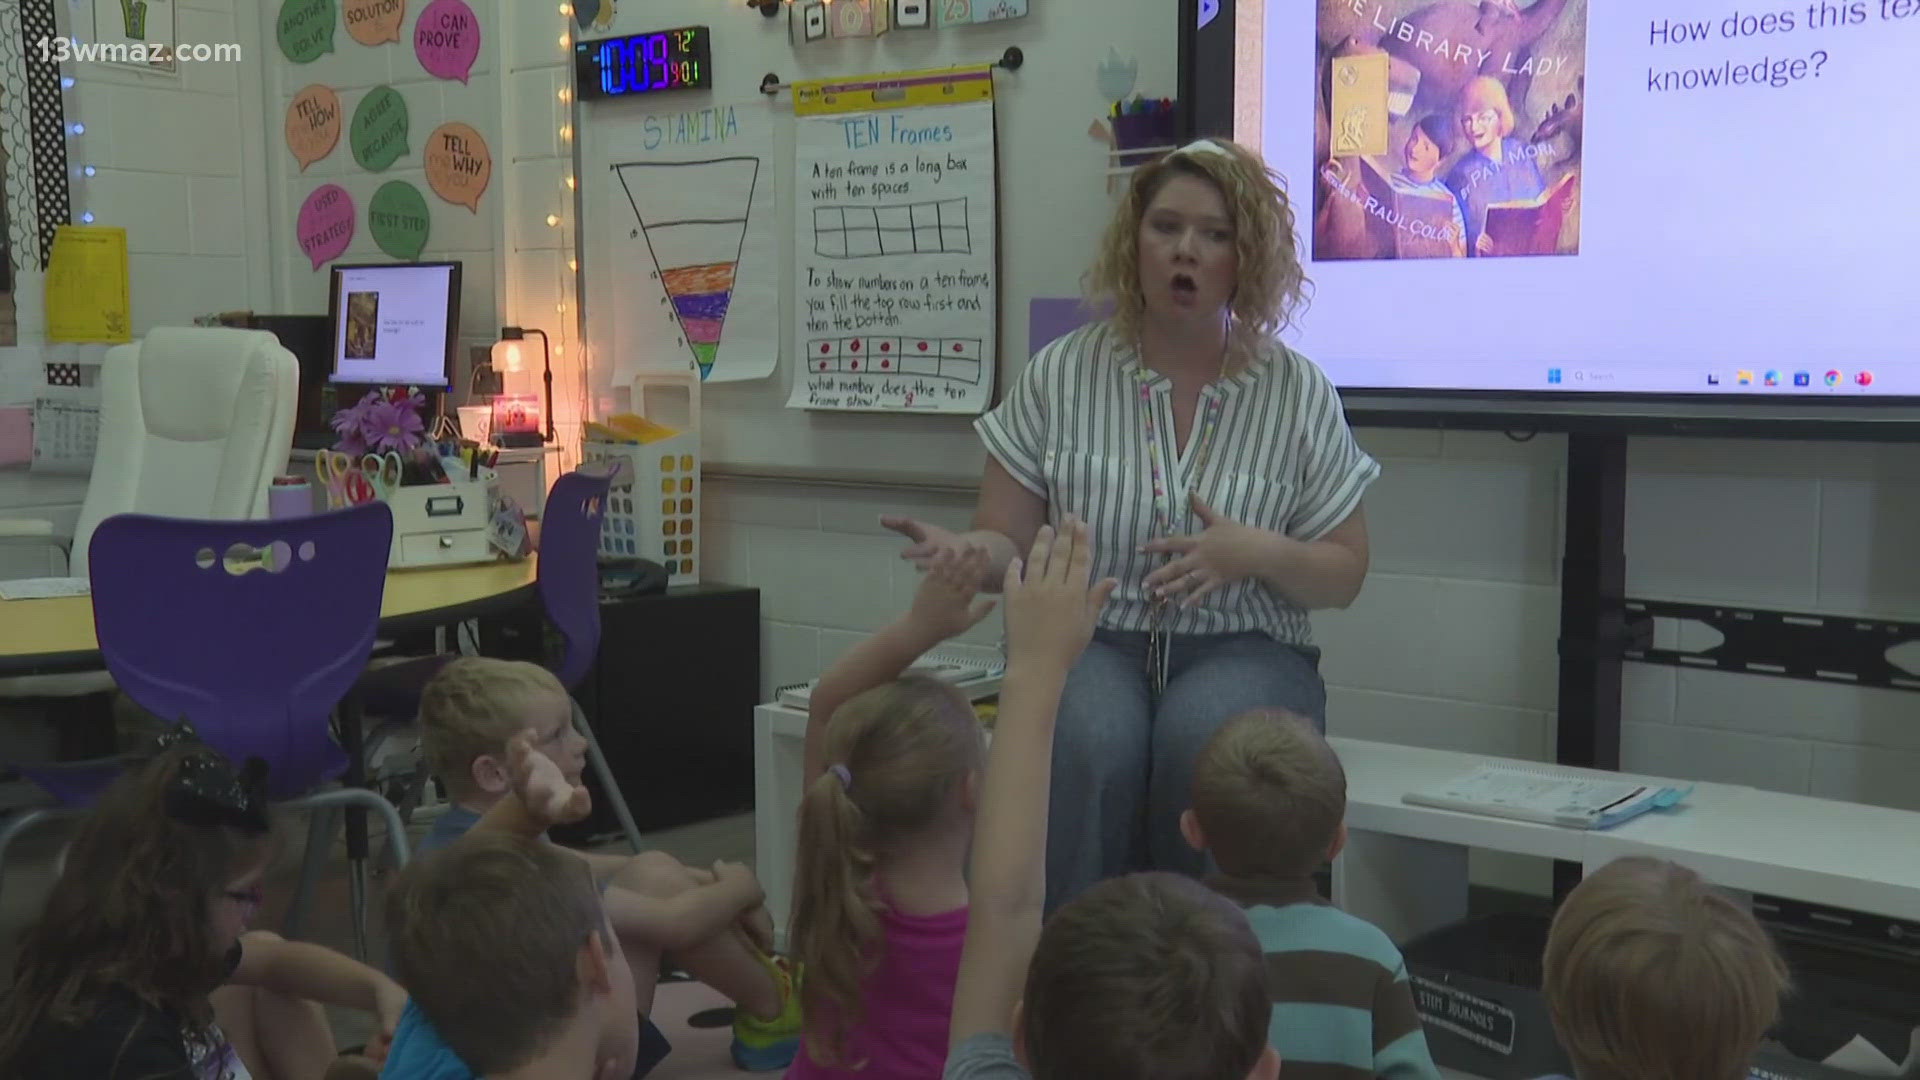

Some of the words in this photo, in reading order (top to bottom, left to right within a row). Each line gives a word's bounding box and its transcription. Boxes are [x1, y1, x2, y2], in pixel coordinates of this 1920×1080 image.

[346, 0, 400, 25] SOLUTION
[440, 15, 468, 31] CAN
[1650, 20, 1711, 46] How
[1720, 11, 1795, 39] does
[1807, 0, 1867, 29] this
[419, 31, 461, 49] PROVE
[1372, 6, 1492, 68] LIBRARY
[1502, 52, 1568, 76] LADY
[600, 32, 670, 95] 10:09
[1647, 50, 1829, 92] knowledge?
[296, 95, 321, 119] TELL
[308, 104, 336, 131] HOW
[643, 105, 738, 150] STAMINA
[844, 116, 879, 149] TEN
[891, 114, 953, 146] Frames
[443, 133, 472, 156] TELL
[452, 154, 483, 177] WHY
[812, 162, 821, 179] A
[825, 162, 843, 179] ten
[848, 160, 879, 177] frame
[885, 162, 895, 175] is
[900, 163, 909, 174] a
[915, 155, 942, 184] long
[947, 152, 968, 171] box
[1470, 162, 1501, 188] PAT
[1507, 143, 1557, 168] MORA
[314, 190, 340, 212] USED
[811, 182, 837, 200] with
[847, 181, 866, 198] ten
[369, 210, 399, 229] FIRST
[401, 216, 427, 232] STEP
[1363, 197, 1408, 231] RAUL
[302, 215, 352, 252] STRATEGY
[807, 267, 821, 288] To
[826, 269, 852, 289] show
[899, 279, 914, 291] on
[920, 276, 929, 289] a
[936, 270, 956, 288] ten
[806, 296, 825, 315] you
[831, 293, 848, 311] fill
[851, 294, 870, 311] the
[874, 293, 894, 315] top
[899, 298, 921, 311] row
[924, 293, 953, 311] first
[957, 294, 982, 311] and
[833, 315, 852, 332] the
[808, 392, 840, 407] frame
[839, 376, 874, 394] number
[881, 378, 907, 397] does
[912, 379, 935, 398] the
[944, 381, 967, 400] ten
